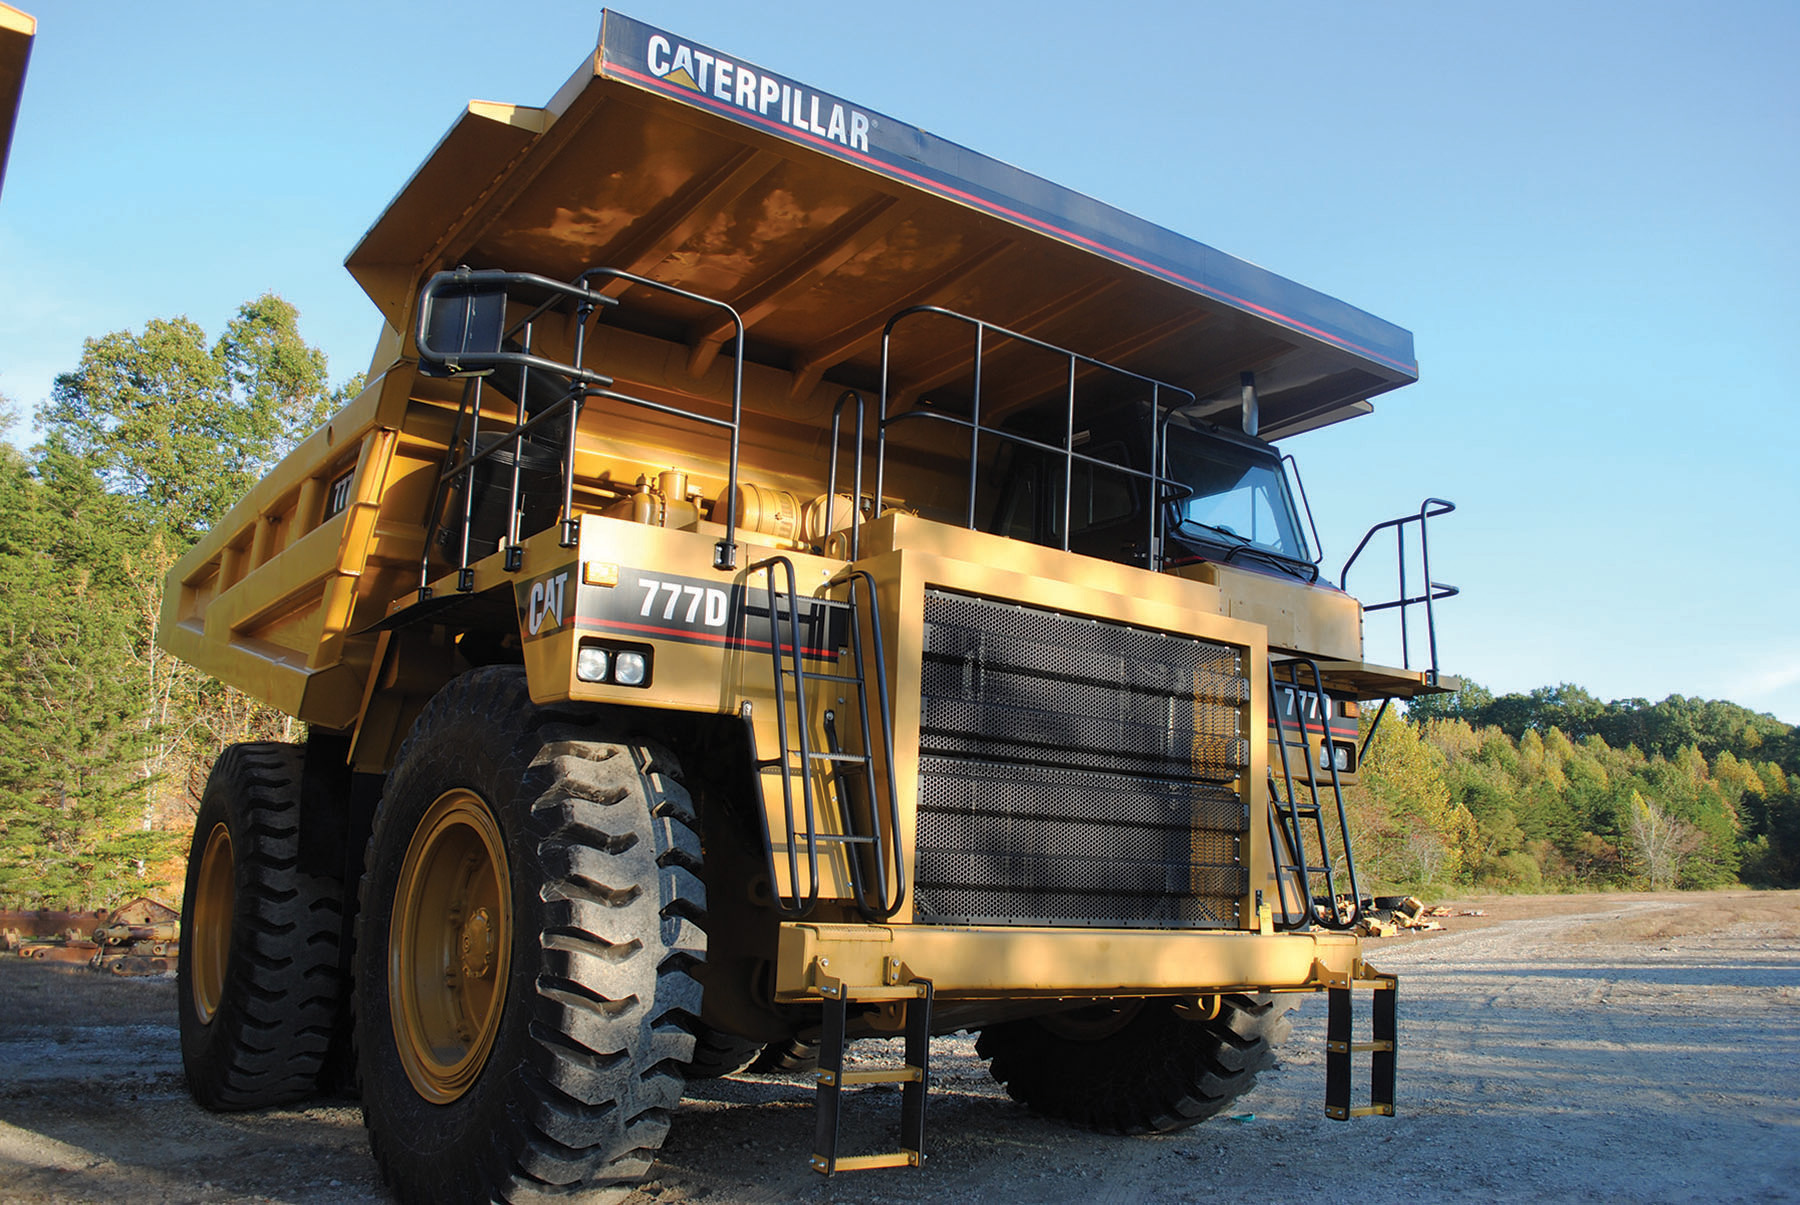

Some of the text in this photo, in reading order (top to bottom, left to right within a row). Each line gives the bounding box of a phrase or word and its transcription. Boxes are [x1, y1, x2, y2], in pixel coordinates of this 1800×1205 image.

[647, 34, 869, 152] CATERPILLAR
[529, 572, 568, 635] CAT
[638, 578, 728, 627] 777D
